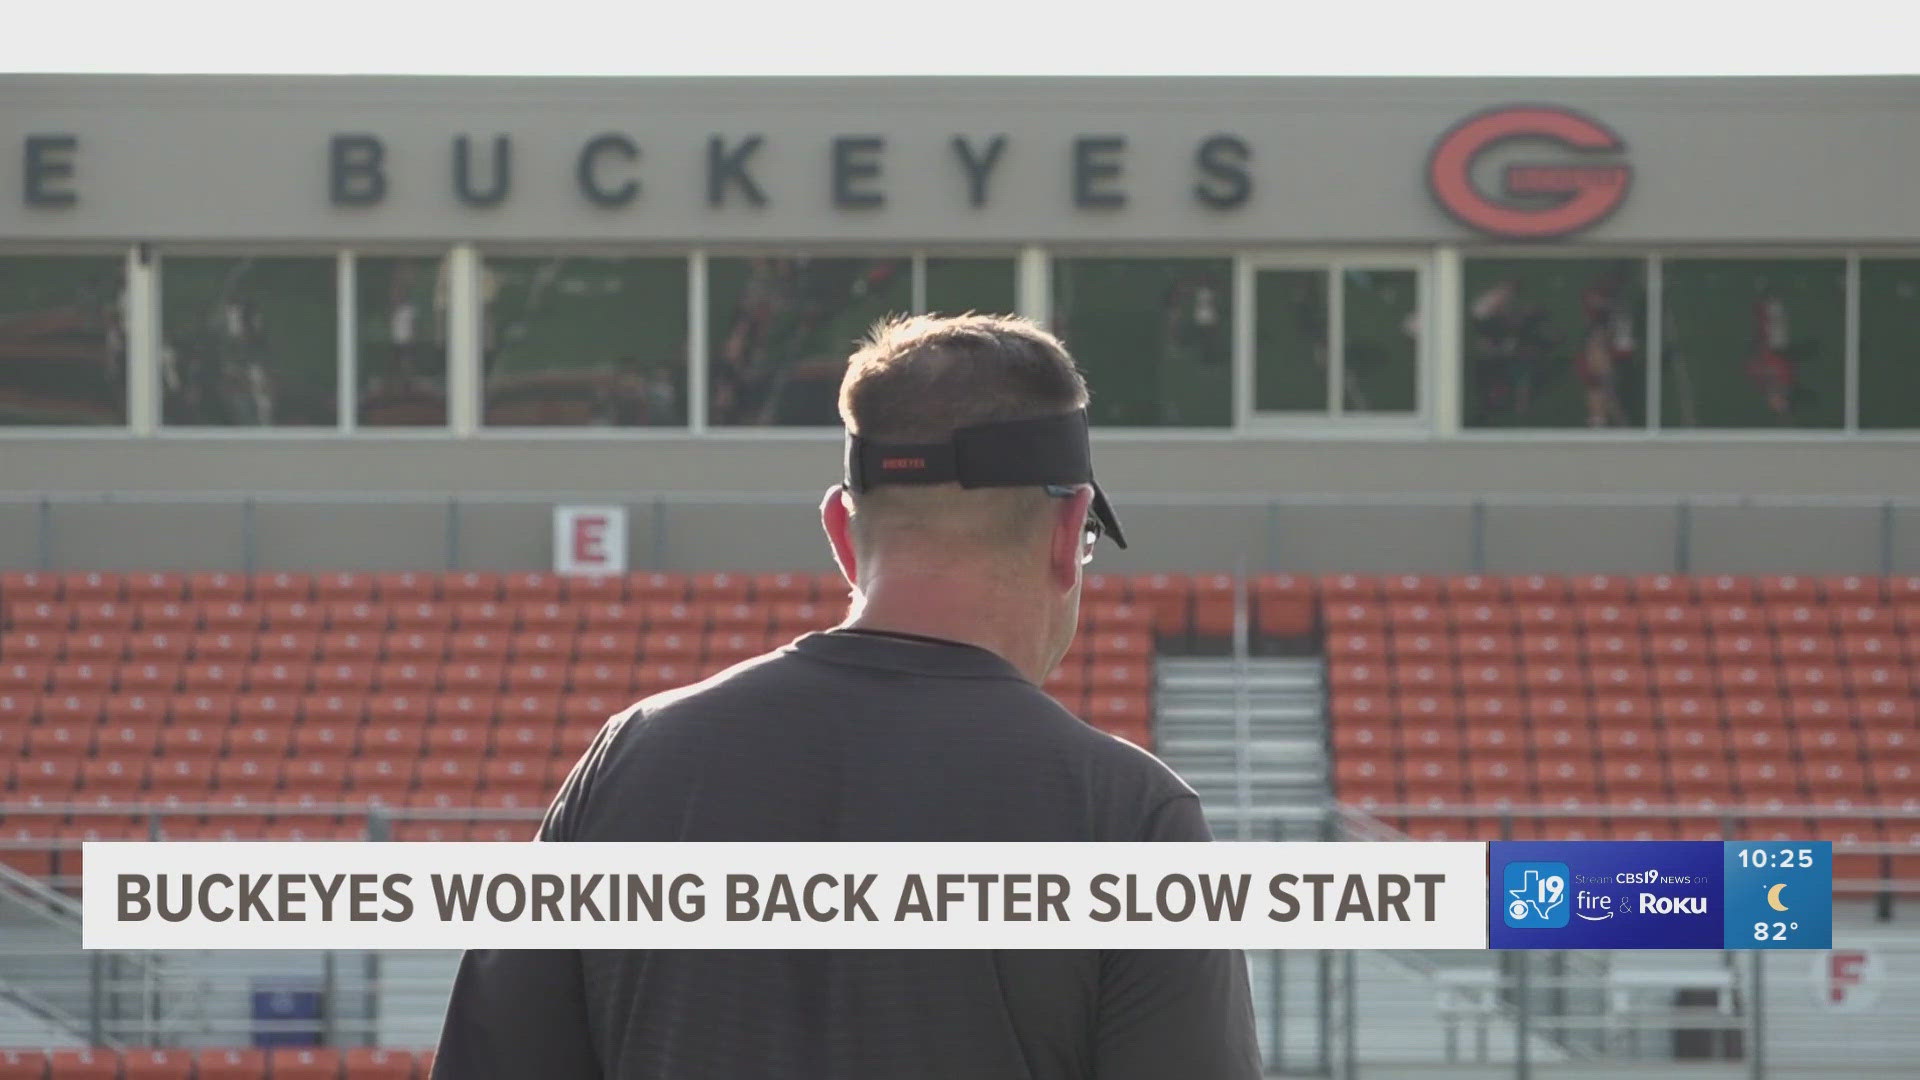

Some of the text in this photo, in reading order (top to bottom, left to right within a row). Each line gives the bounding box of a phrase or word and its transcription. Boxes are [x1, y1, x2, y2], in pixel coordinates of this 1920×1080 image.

[23, 134, 1255, 210] E BUCKEYES
[1425, 103, 1633, 239] G
[572, 515, 609, 563] E
[1828, 951, 1869, 1004] F
